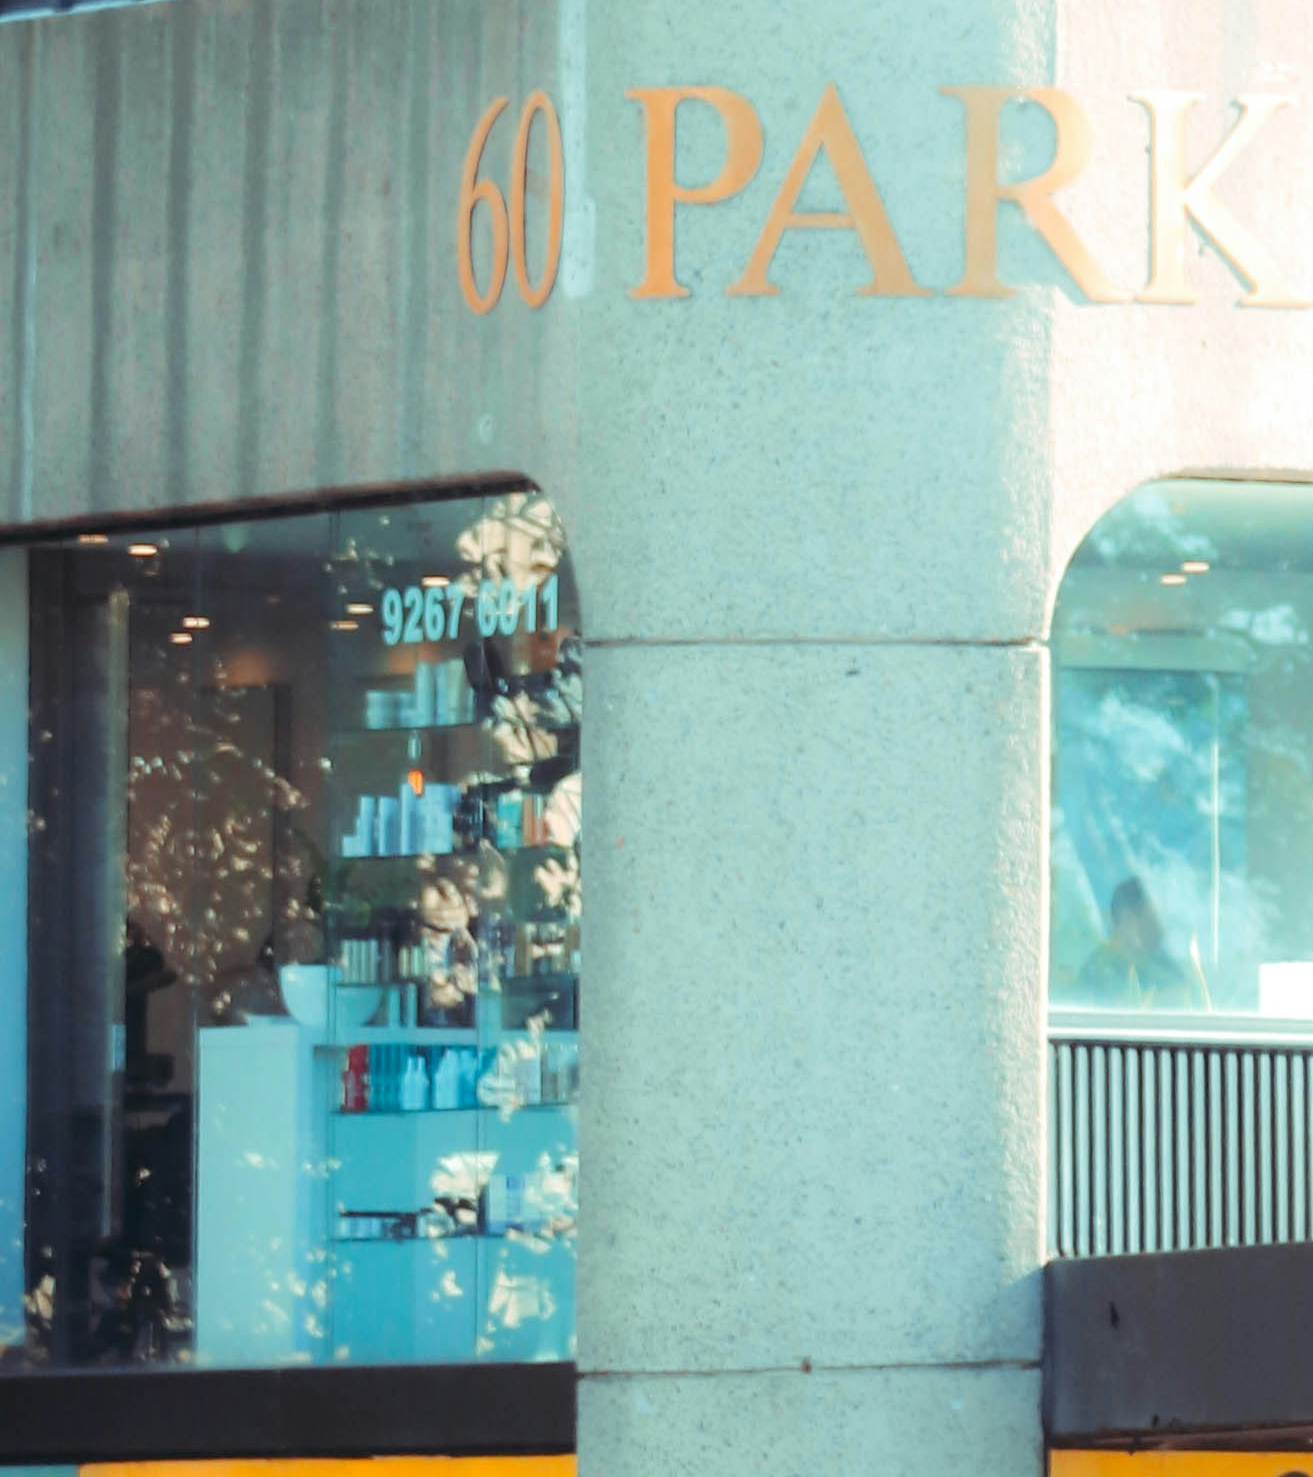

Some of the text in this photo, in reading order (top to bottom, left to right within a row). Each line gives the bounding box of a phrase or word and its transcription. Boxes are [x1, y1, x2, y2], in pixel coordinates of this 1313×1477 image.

[457, 81, 1313, 313] 60 PARK
[381, 575, 559, 646] 9267 6011
